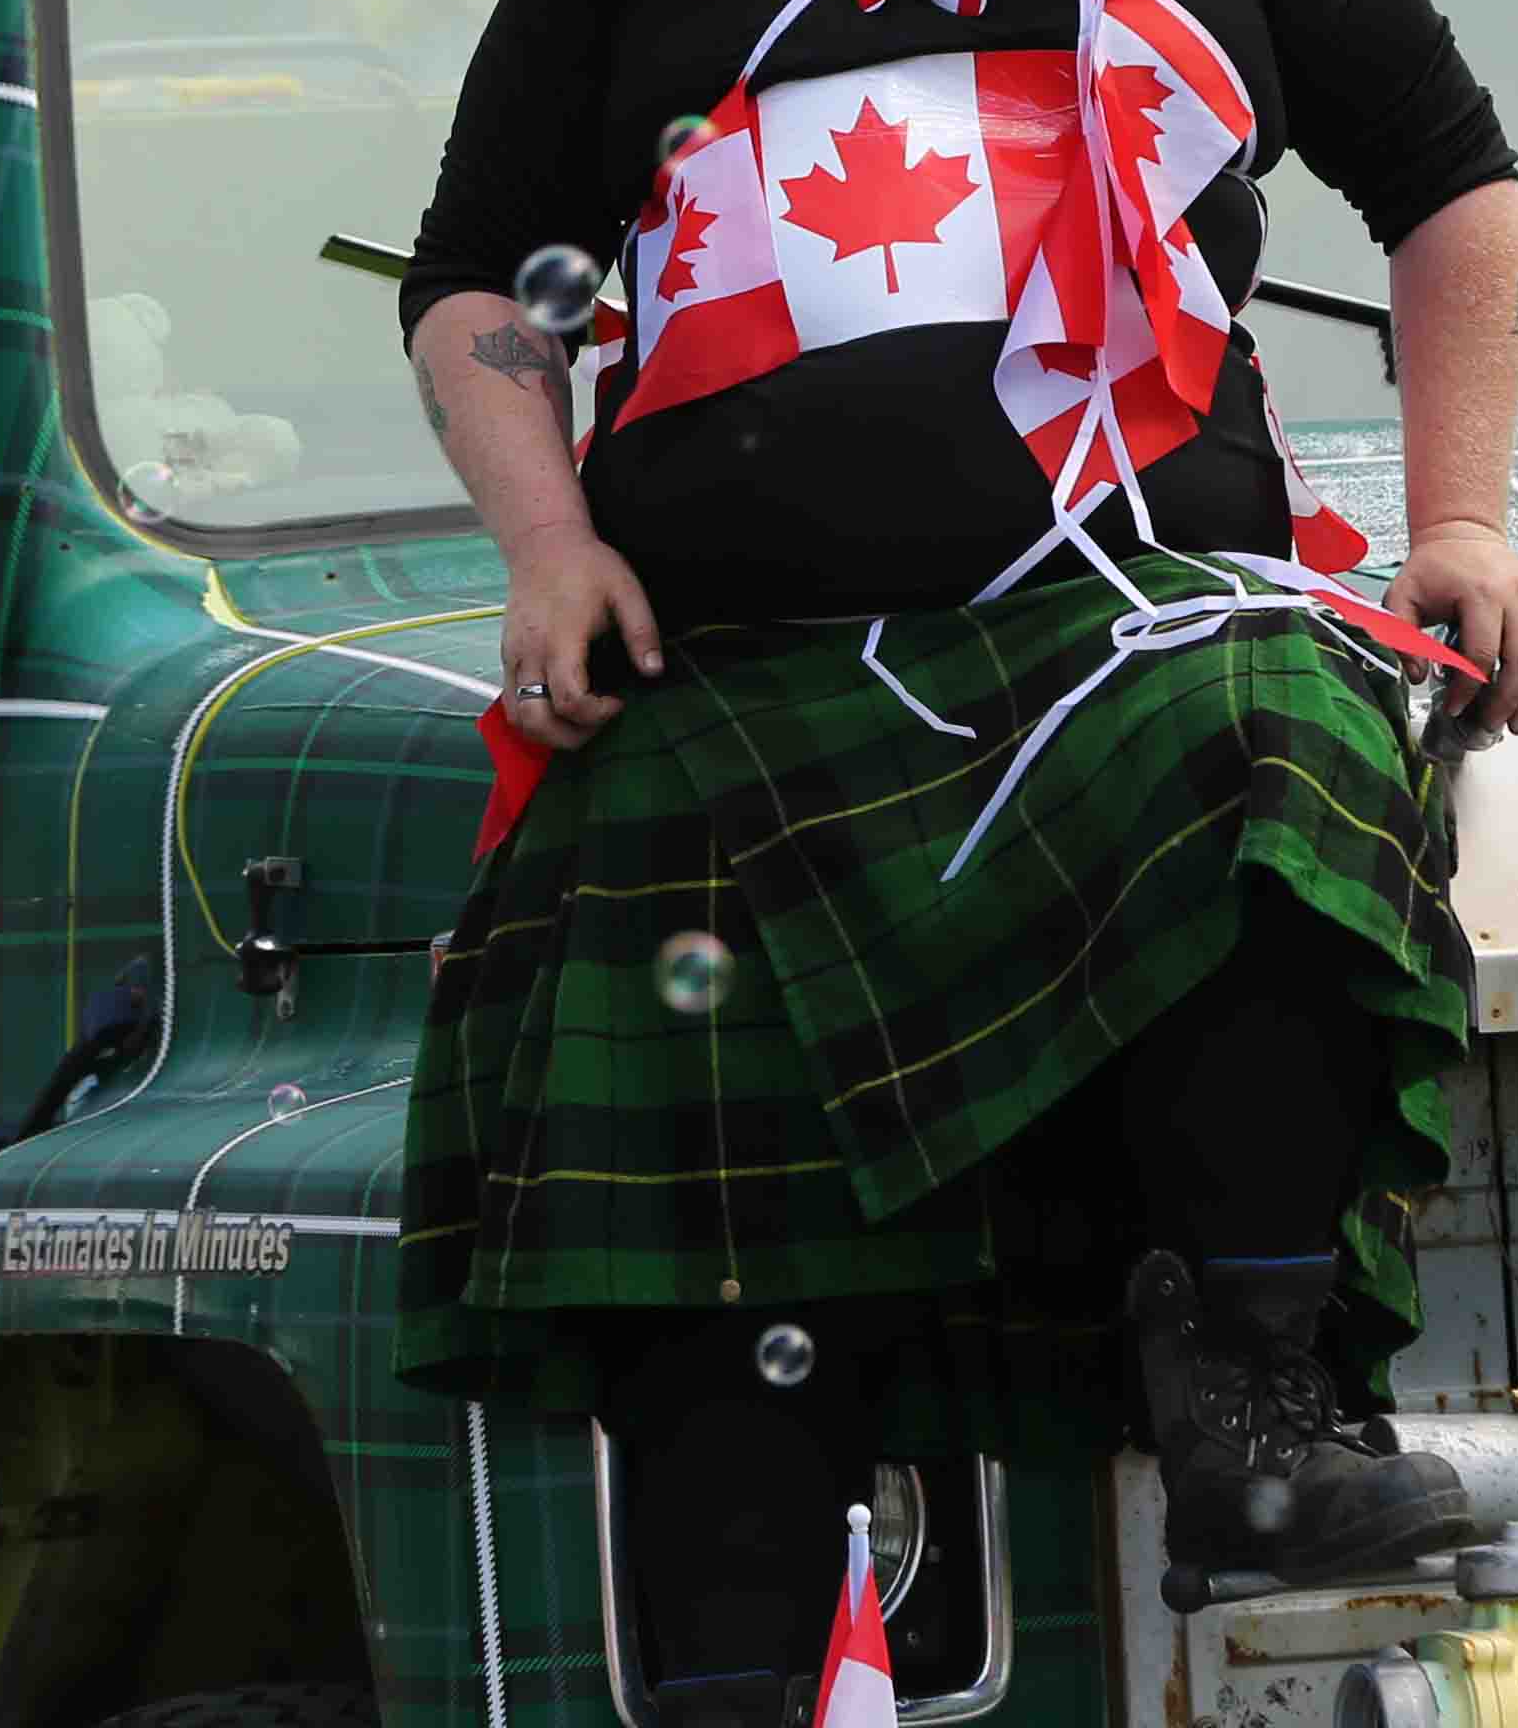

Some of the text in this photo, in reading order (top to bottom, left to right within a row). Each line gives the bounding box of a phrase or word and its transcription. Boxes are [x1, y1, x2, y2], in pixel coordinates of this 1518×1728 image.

[2, 1213, 135, 1272] Estimates
[139, 1210, 168, 1270] In
[173, 1208, 295, 1271] Minutes
